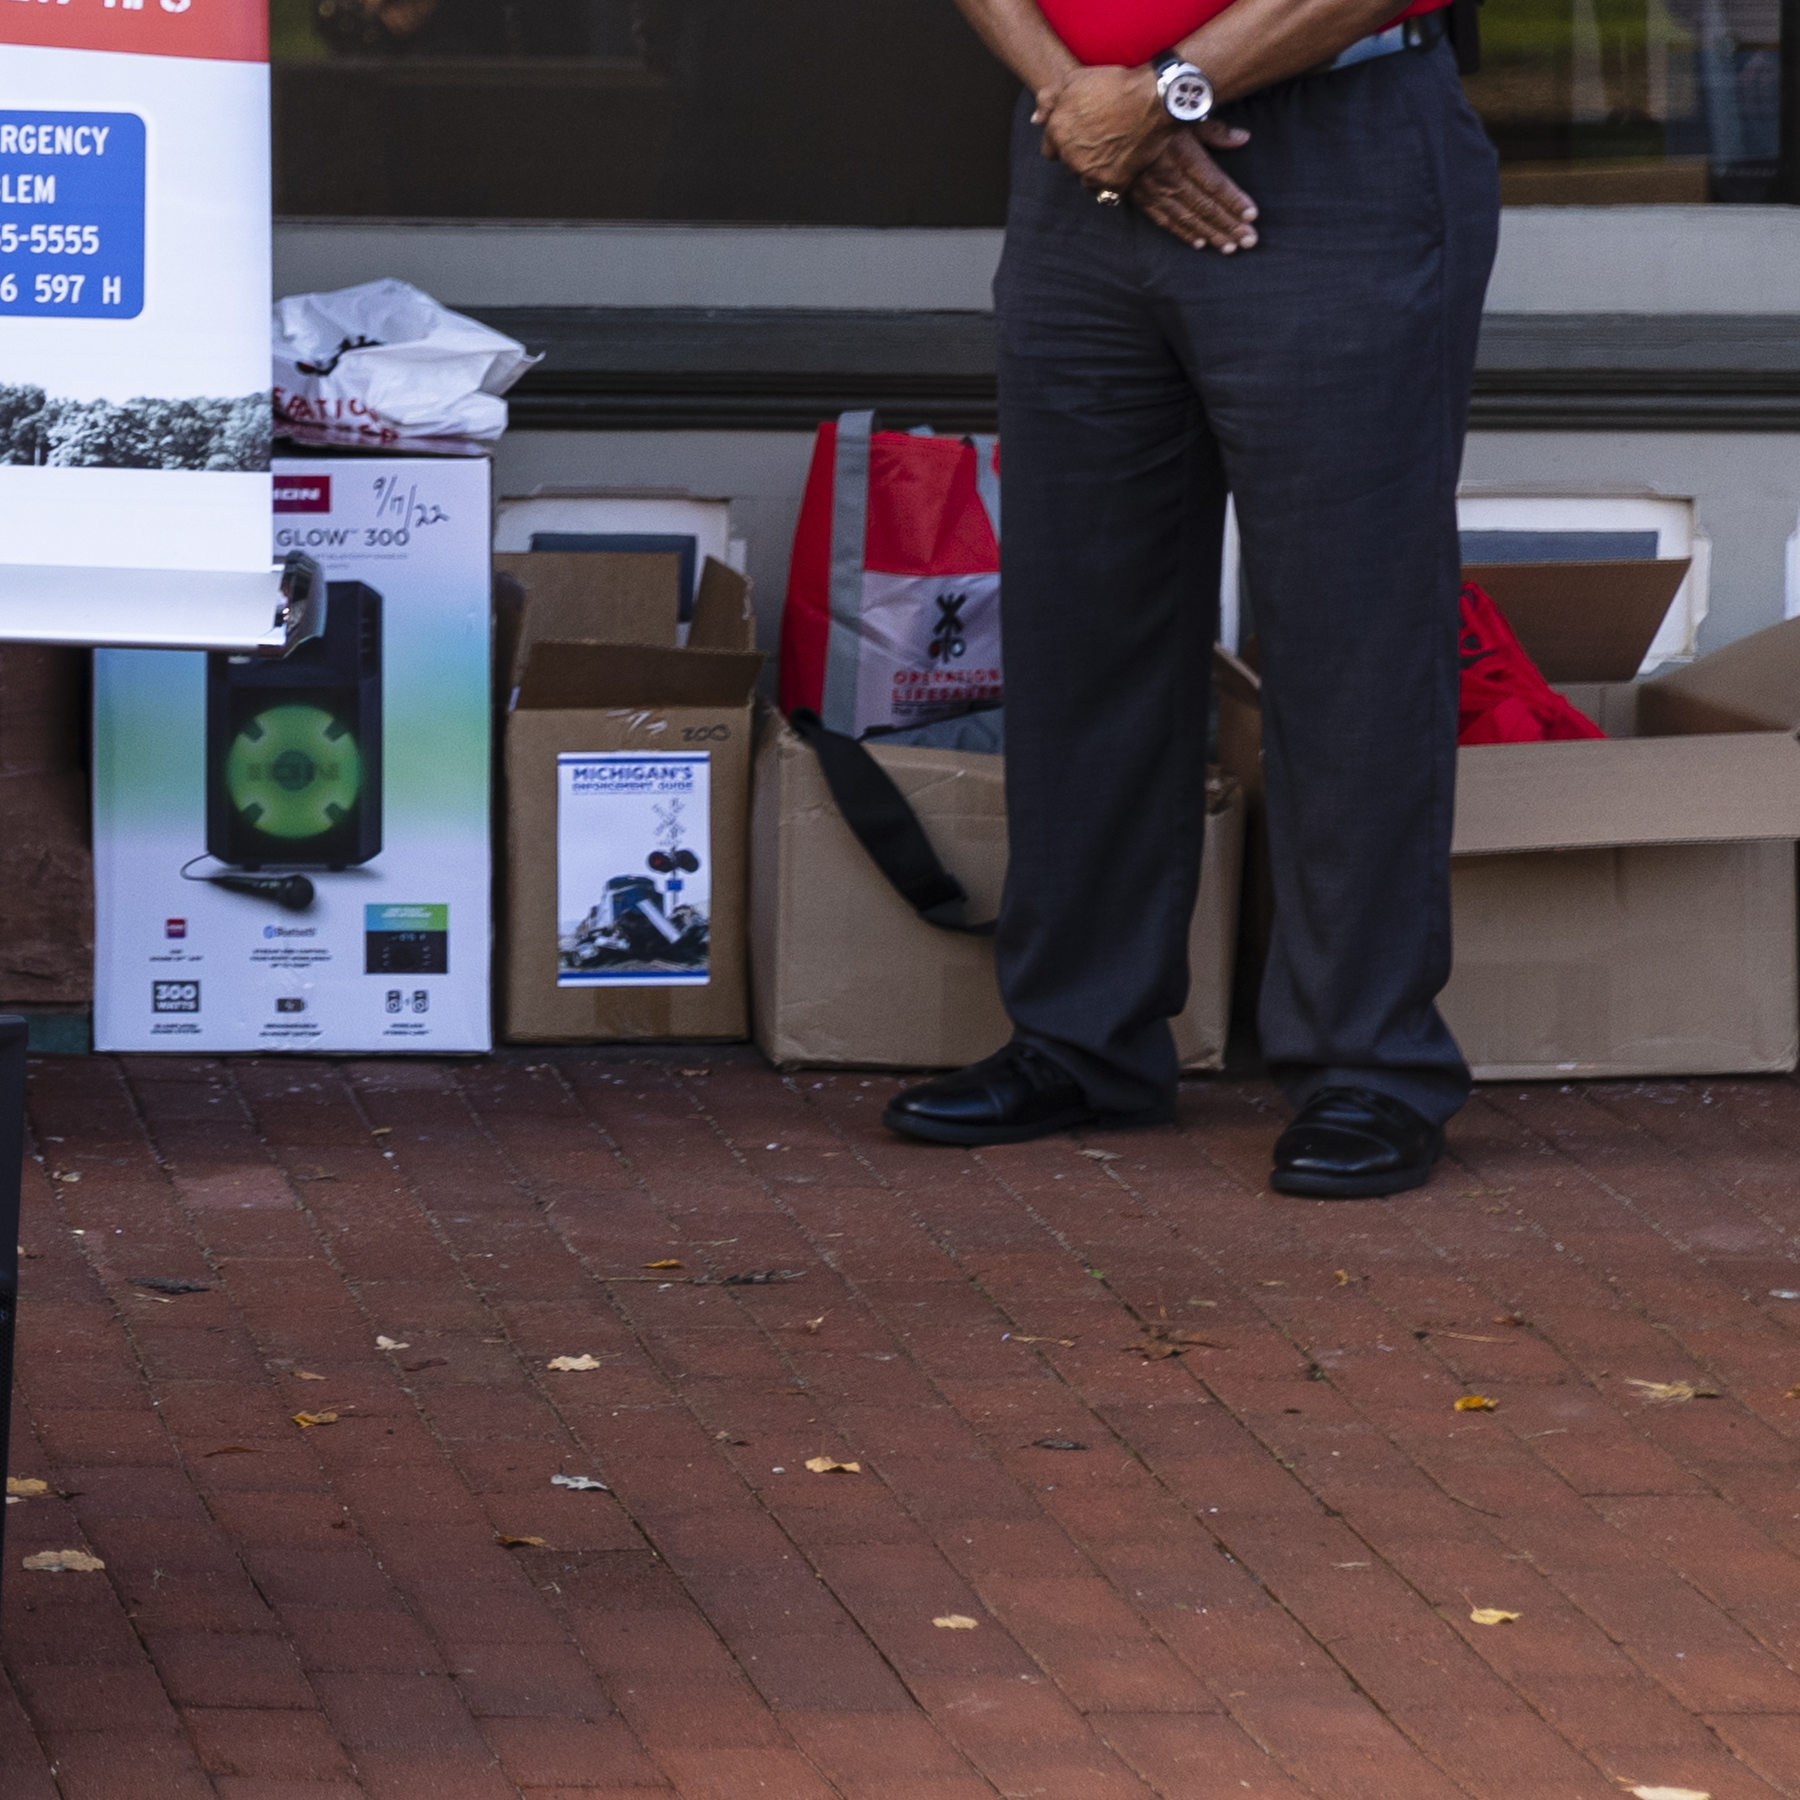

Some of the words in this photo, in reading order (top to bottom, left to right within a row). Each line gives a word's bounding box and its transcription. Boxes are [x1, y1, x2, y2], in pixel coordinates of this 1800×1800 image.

[33, 273, 86, 305] 597
[101, 274, 122, 306] H
[363, 528, 411, 547] 300
